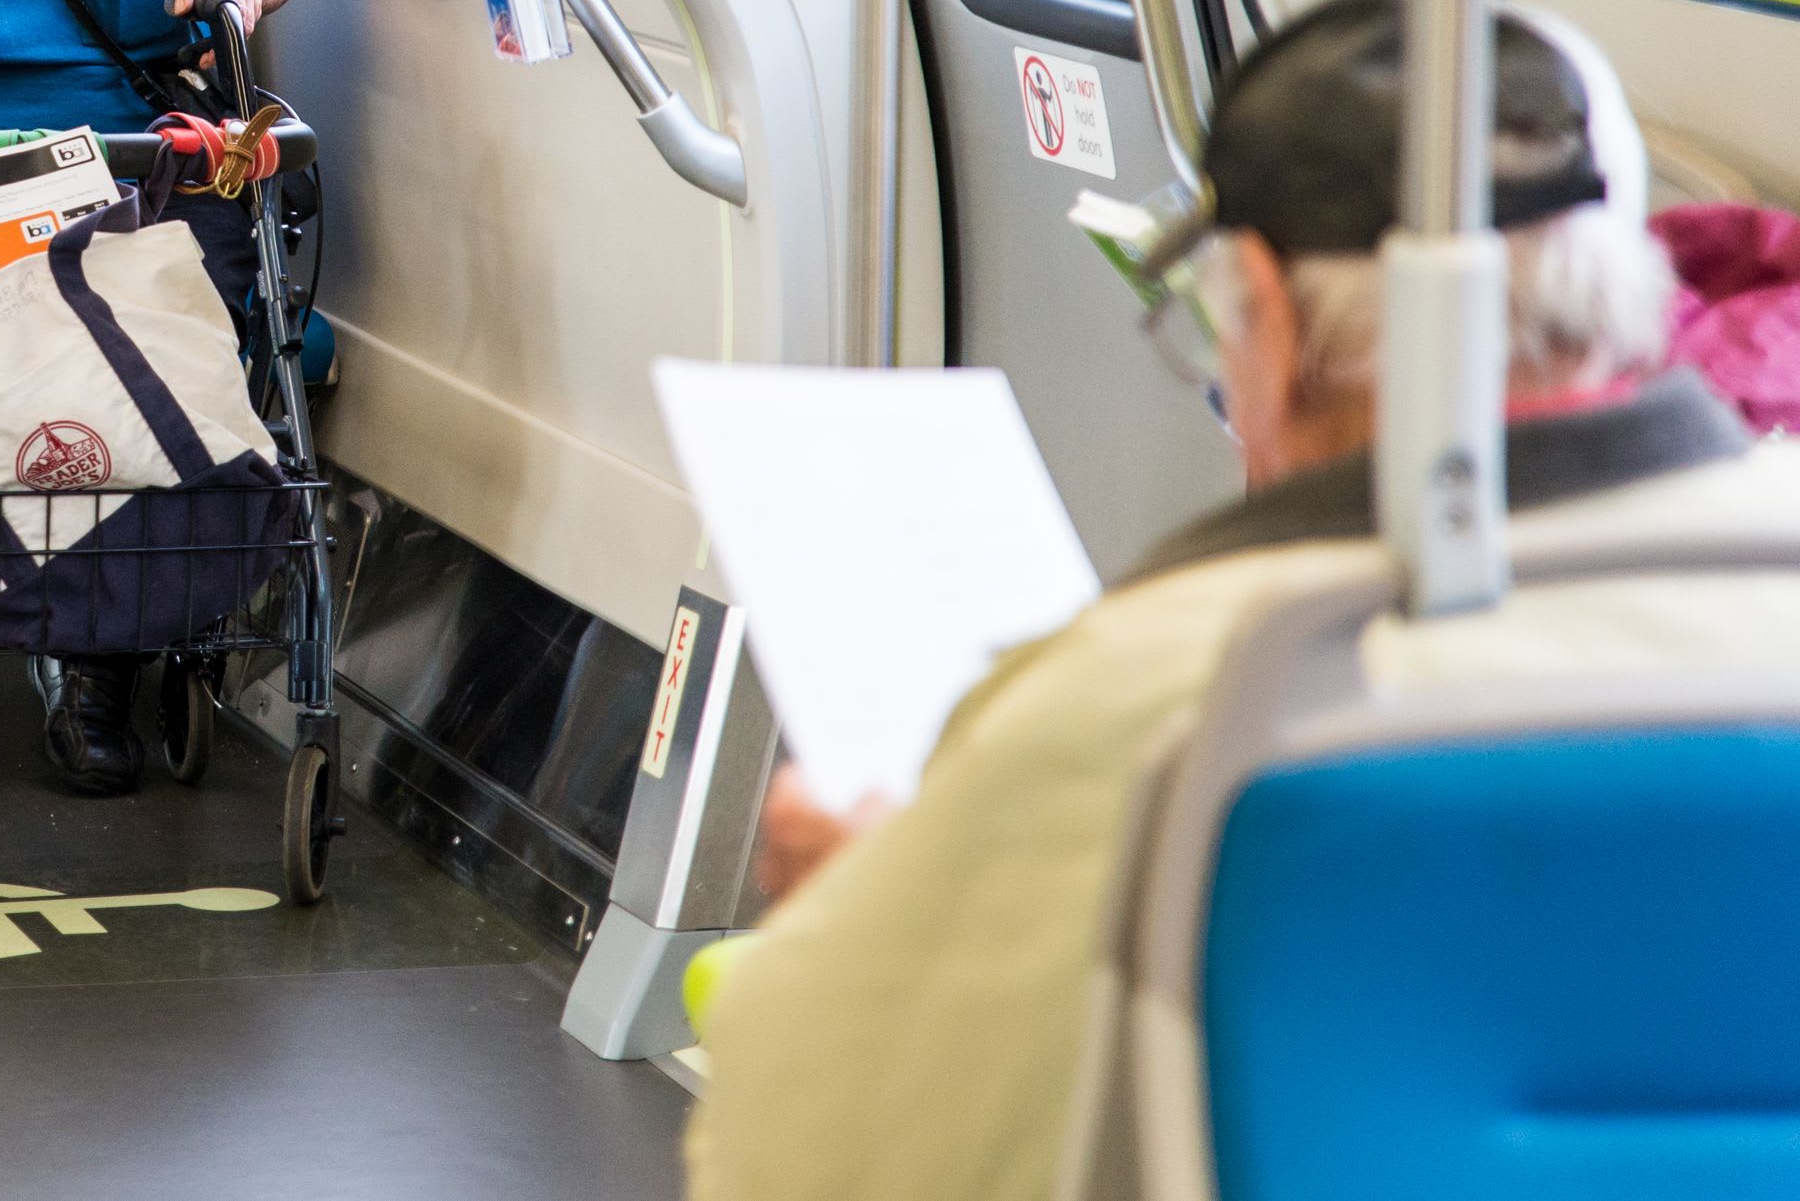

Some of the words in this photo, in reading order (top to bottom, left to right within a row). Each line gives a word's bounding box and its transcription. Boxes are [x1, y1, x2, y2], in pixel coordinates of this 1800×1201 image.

[1062, 75, 1076, 95] Do
[1077, 77, 1097, 98] NOT
[1075, 103, 1096, 127] hold
[1078, 134, 1102, 158] doors
[33, 452, 102, 486] TRADER
[52, 469, 100, 489] JOE'S
[653, 619, 690, 762] EXIT
